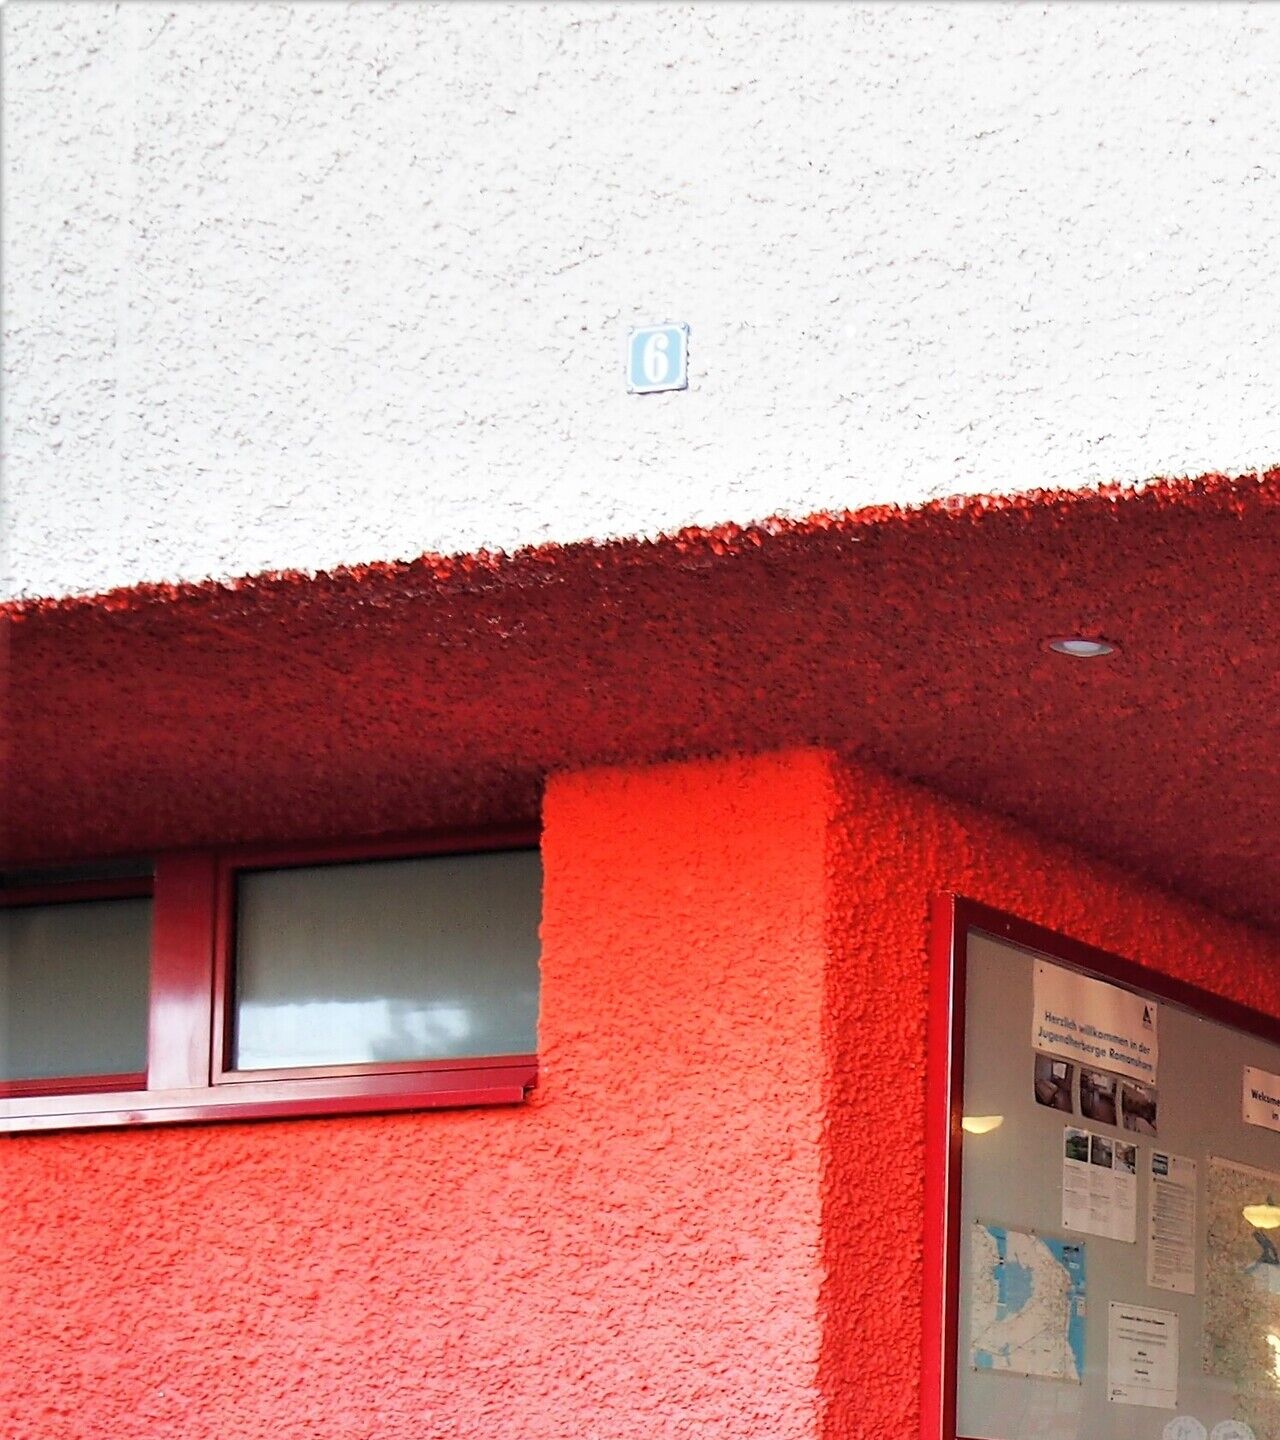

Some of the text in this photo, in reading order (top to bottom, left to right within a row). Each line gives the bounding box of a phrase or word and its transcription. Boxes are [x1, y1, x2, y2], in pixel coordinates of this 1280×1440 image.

[643, 332, 669, 384] 6
[1038, 1026, 1152, 1071] Jugendherberge Romanshorn
[1044, 1011, 1077, 1031] Herzlich
[1079, 1024, 1129, 1047] willkommen
[1130, 1040, 1138, 1050] in
[1139, 1042, 1150, 1055] der
[1251, 1089, 1280, 1107] Welcome
[1272, 1112, 1279, 1120] in
